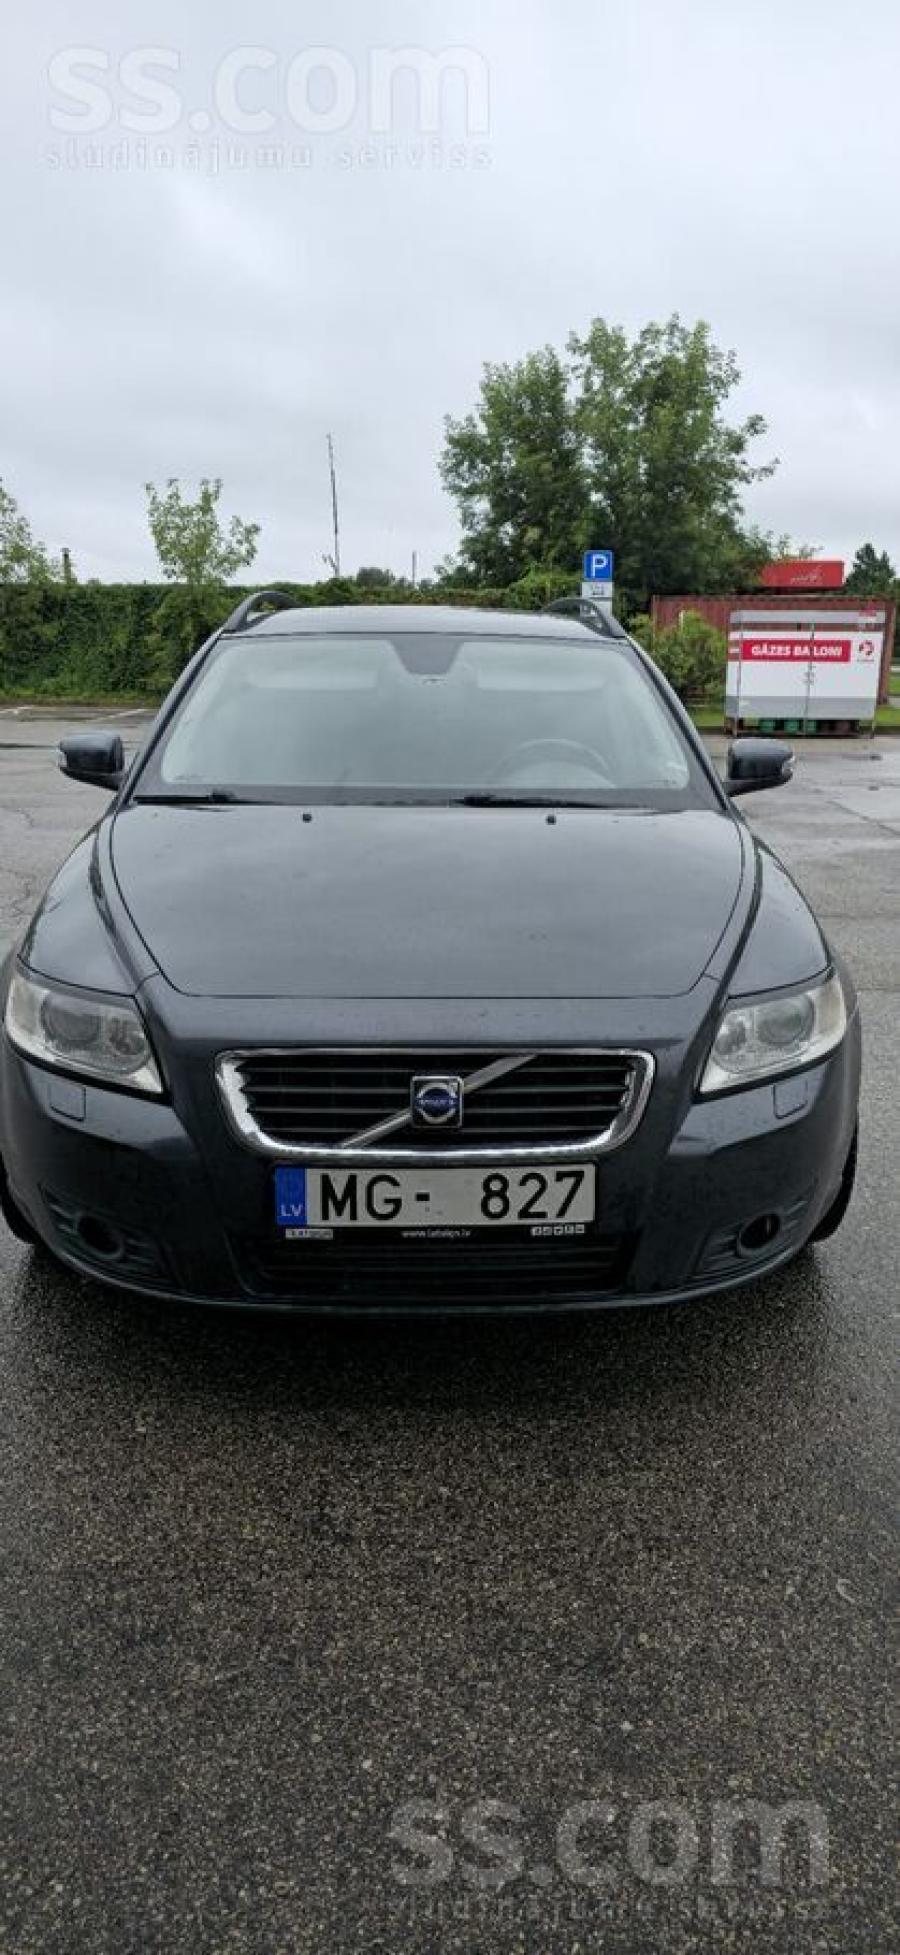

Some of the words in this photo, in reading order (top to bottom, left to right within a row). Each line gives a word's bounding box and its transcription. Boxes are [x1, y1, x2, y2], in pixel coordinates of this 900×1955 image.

[591, 554, 609, 578] P
[480, 1169, 586, 1220] 827
[280, 1204, 303, 1217] LV
